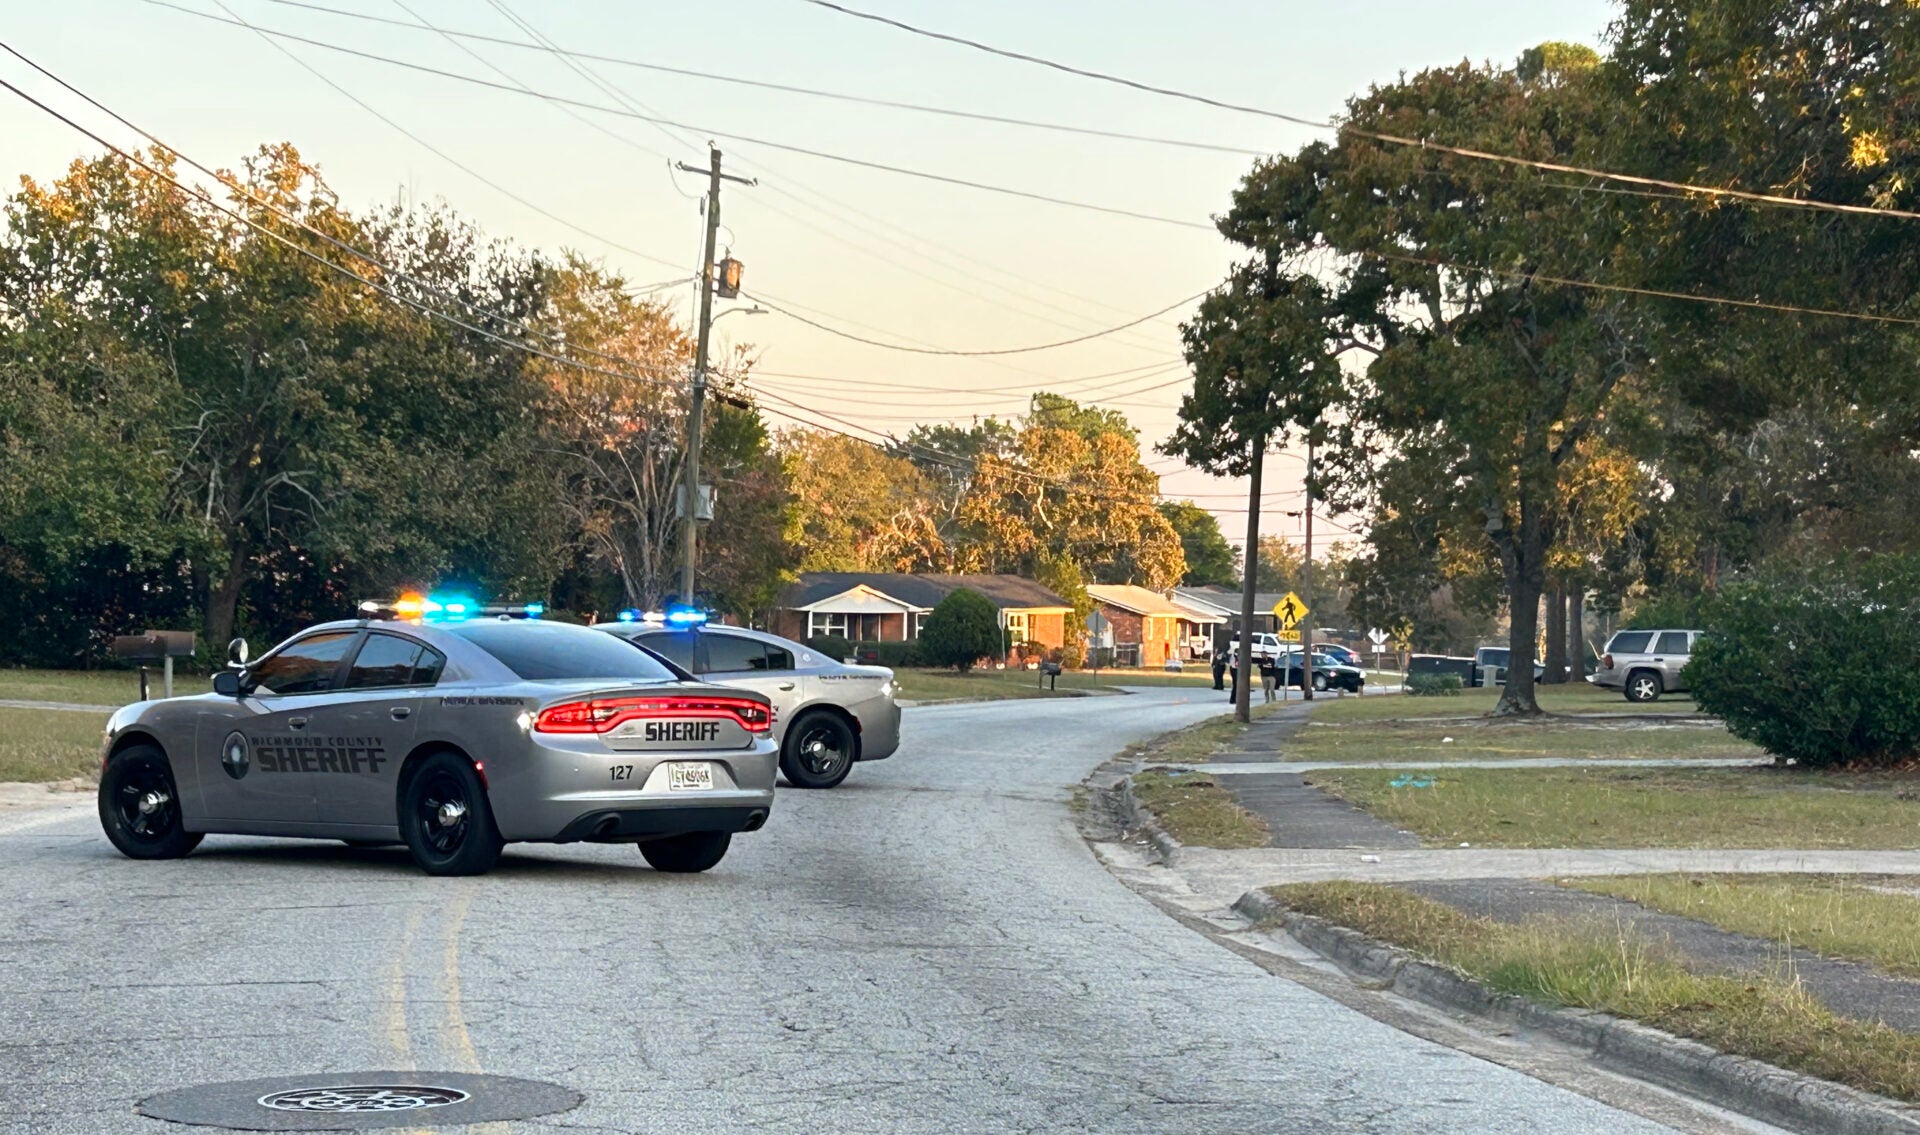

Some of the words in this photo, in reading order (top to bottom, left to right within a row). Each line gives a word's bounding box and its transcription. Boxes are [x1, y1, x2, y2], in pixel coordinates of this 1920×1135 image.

[645, 722, 719, 741] SHERIFF
[251, 736, 322, 747] RICHMOND
[328, 736, 383, 747] COUNTY
[256, 747, 386, 773] SHERIFF
[609, 765, 634, 780] 127
